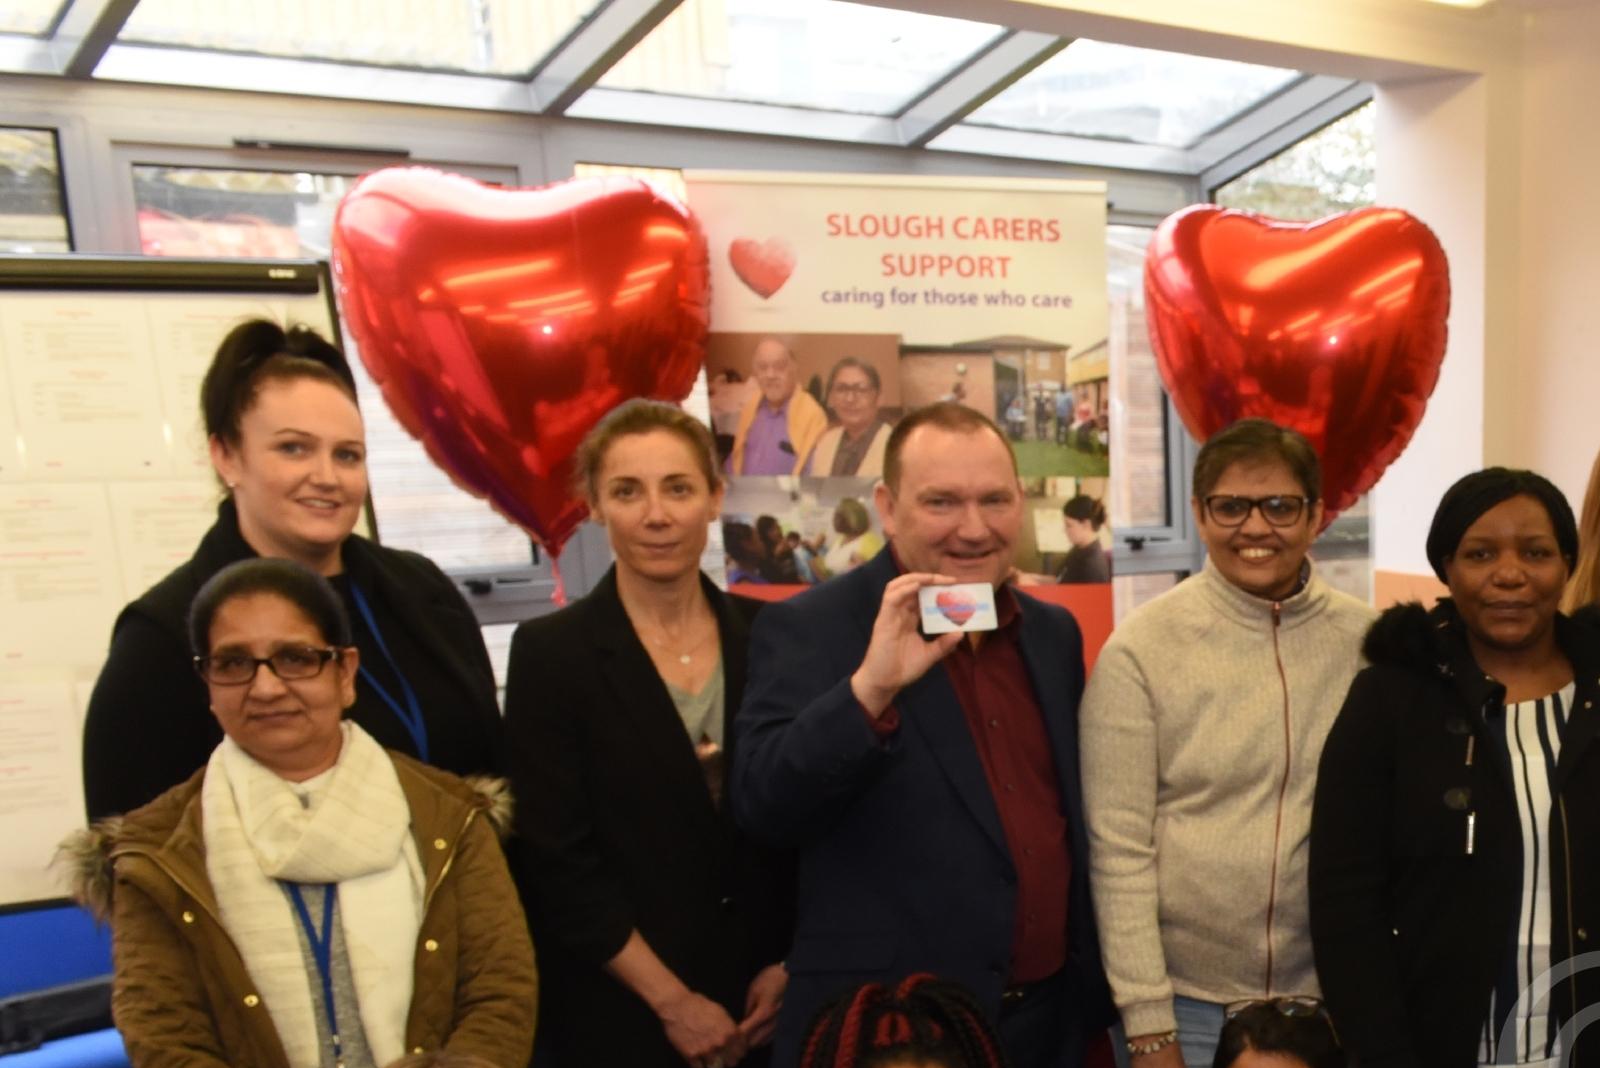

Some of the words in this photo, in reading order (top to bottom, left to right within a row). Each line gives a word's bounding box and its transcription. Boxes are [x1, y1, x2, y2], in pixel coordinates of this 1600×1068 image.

[826, 213, 944, 239] SLOUGH
[953, 216, 1061, 242] CARERS
[881, 254, 1011, 279] SUPPORT
[821, 287, 884, 308] caring
[890, 288, 919, 306] for
[923, 289, 978, 307] those
[983, 291, 1026, 308] who
[1031, 294, 1073, 309] care
